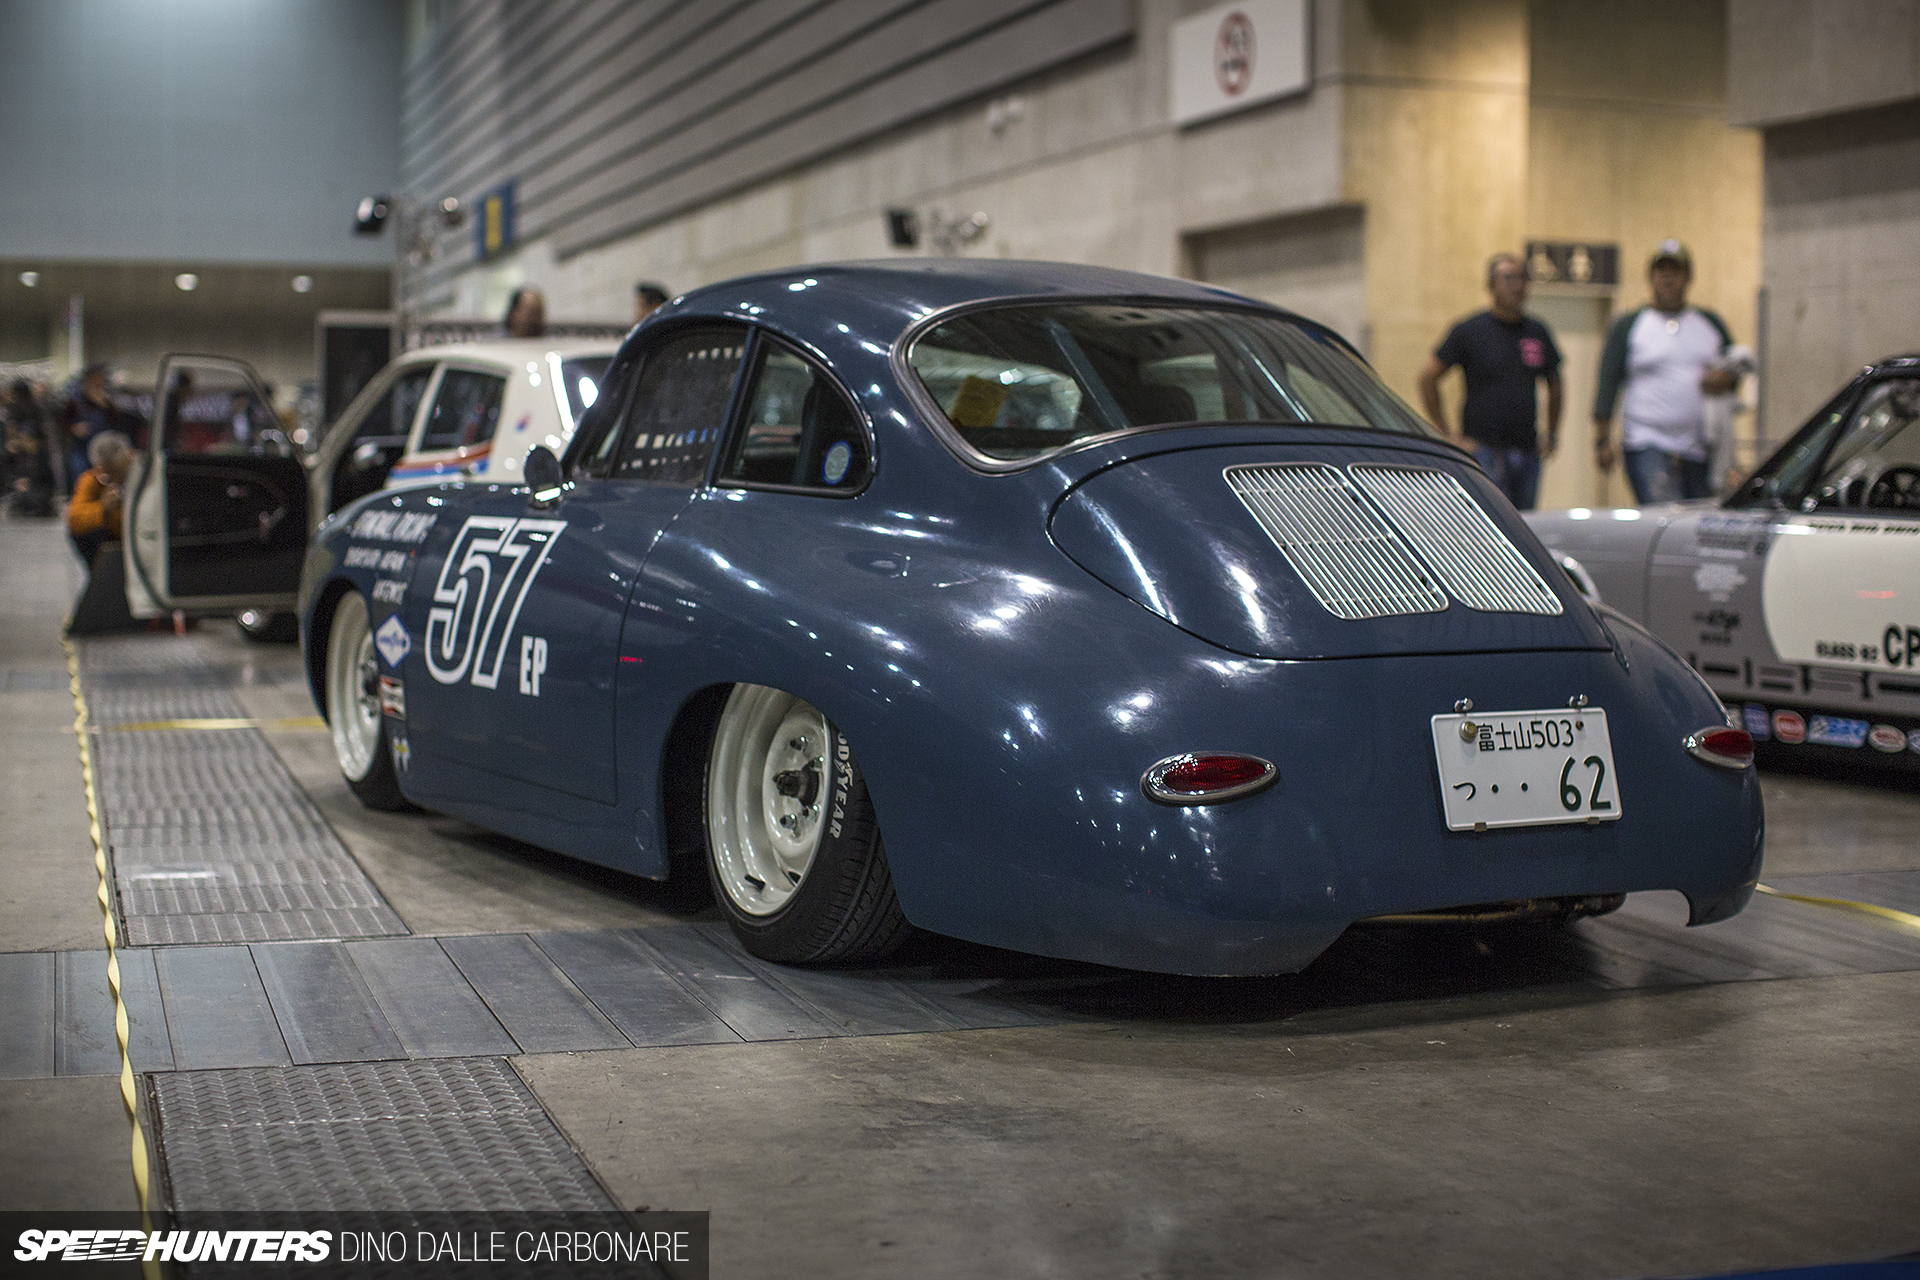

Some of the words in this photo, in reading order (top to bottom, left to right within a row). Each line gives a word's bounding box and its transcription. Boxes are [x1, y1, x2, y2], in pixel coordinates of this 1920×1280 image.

[425, 516, 568, 689] 57
[519, 636, 548, 697] EP
[1476, 720, 1574, 752] 富士山503
[1560, 756, 1611, 811] 62
